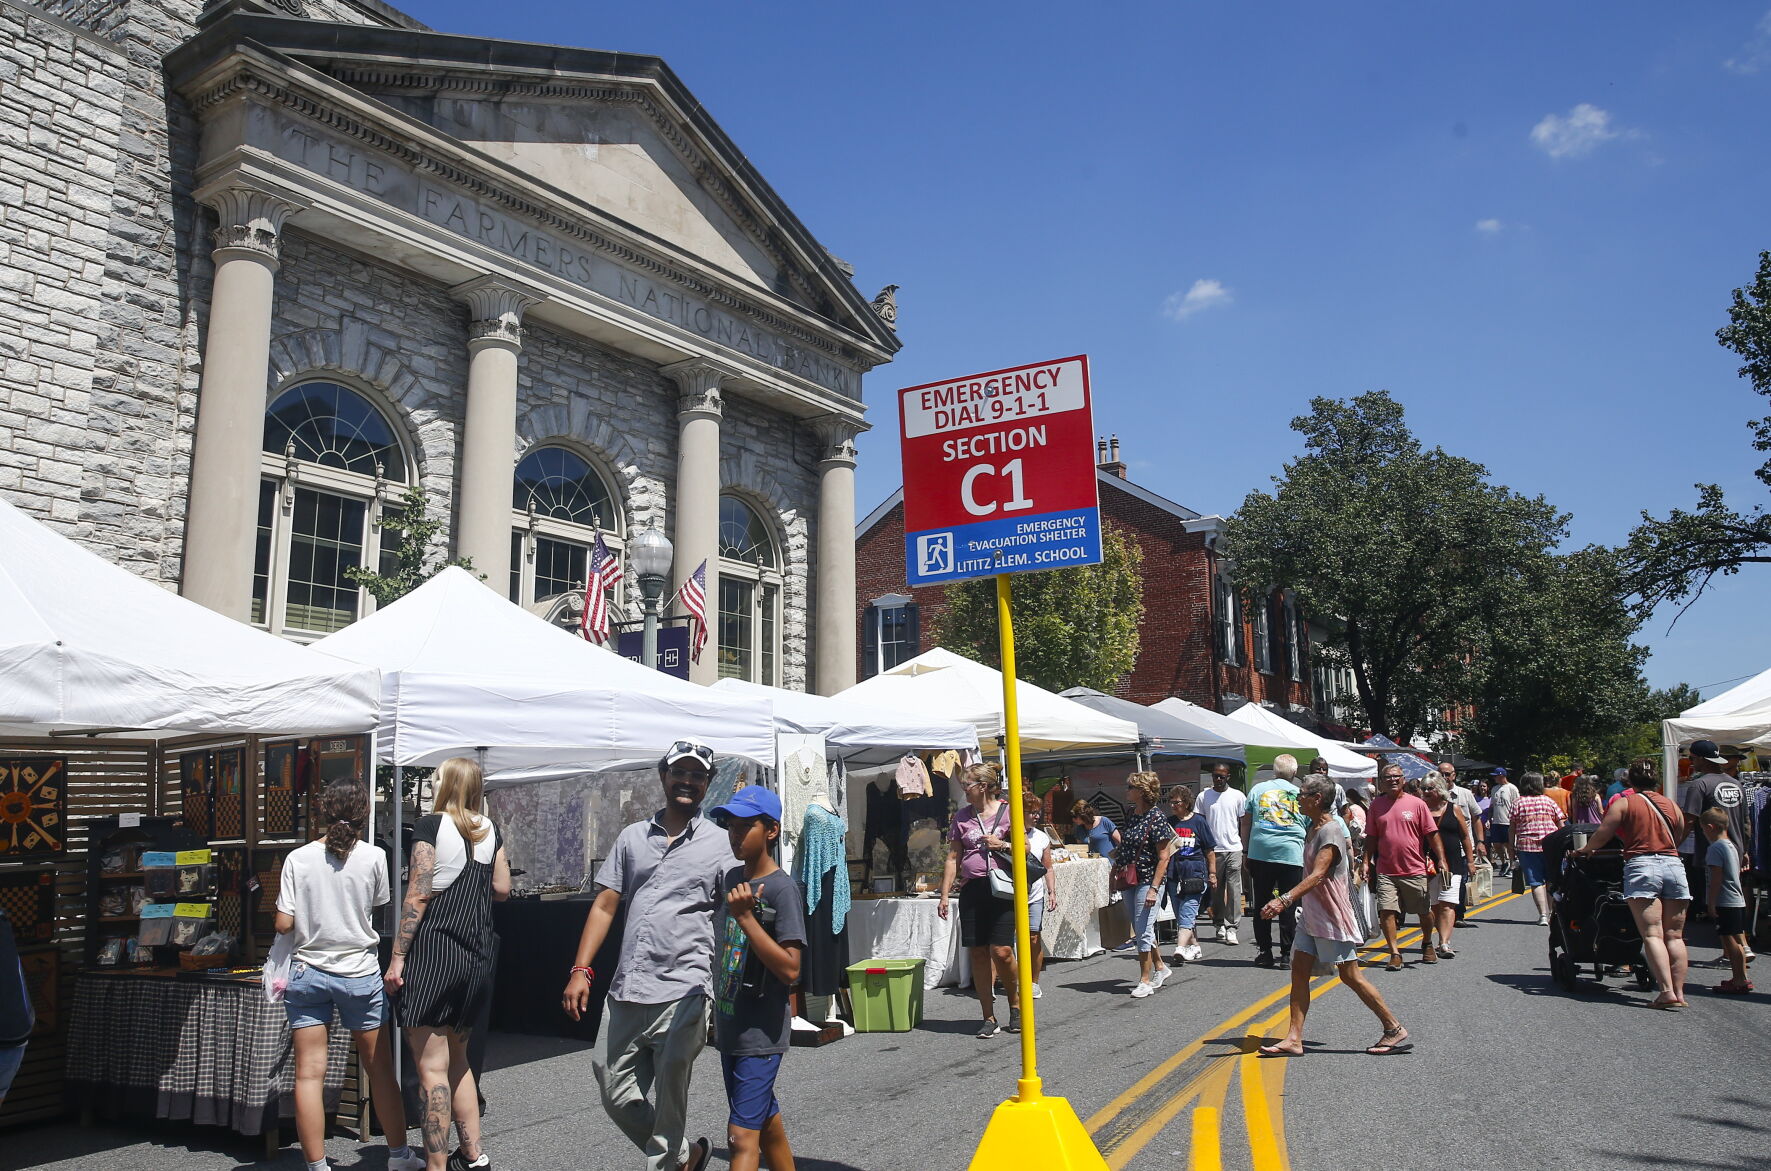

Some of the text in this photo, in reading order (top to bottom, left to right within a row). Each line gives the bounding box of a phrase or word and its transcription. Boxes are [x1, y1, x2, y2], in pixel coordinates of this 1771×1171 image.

[291, 128, 846, 391] THE FARMERS NATIONAL BANK
[921, 367, 1061, 411] EMERGENCY
[934, 392, 1050, 430] DIAL 9-1-1
[943, 424, 1047, 462] SECTION
[960, 458, 1033, 516] C1
[969, 528, 1086, 552] EVACUATION SHELTER
[1017, 516, 1086, 534] EMERGENCY
[957, 546, 1088, 573] LITITZ ELEM. SCHOOL
[1717, 788, 1740, 798] VANS
